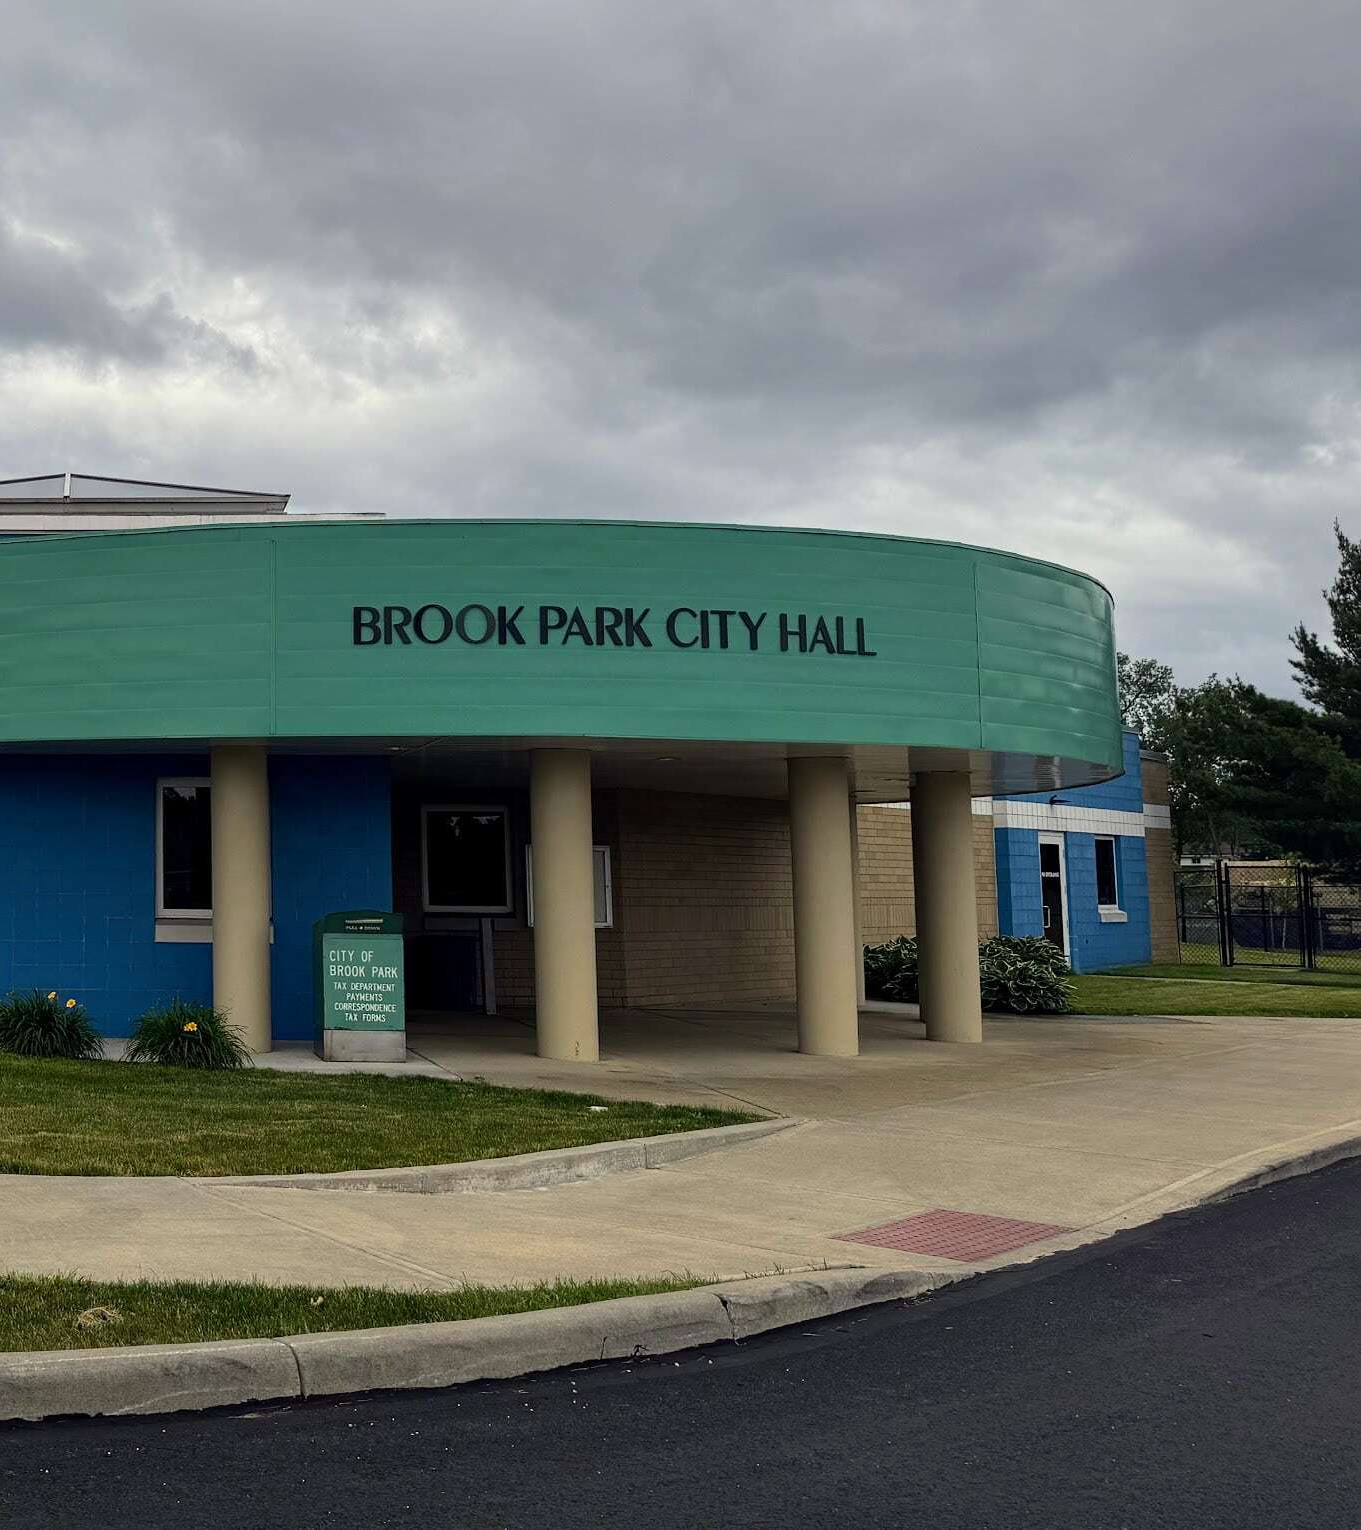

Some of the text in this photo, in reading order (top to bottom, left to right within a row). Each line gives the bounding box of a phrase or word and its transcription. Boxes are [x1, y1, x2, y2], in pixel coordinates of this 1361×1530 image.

[352, 603, 877, 657] BROOK PARK CITY HALL
[329, 950, 374, 962] CITY OF
[329, 965, 398, 978] BROOK PARK
[334, 981, 395, 992] TAX DEPARTMENT
[346, 992, 383, 1001] PAYMENTS
[334, 1002, 397, 1013] CORRESPONDENCE
[345, 1012, 386, 1023] TAX FORMS
